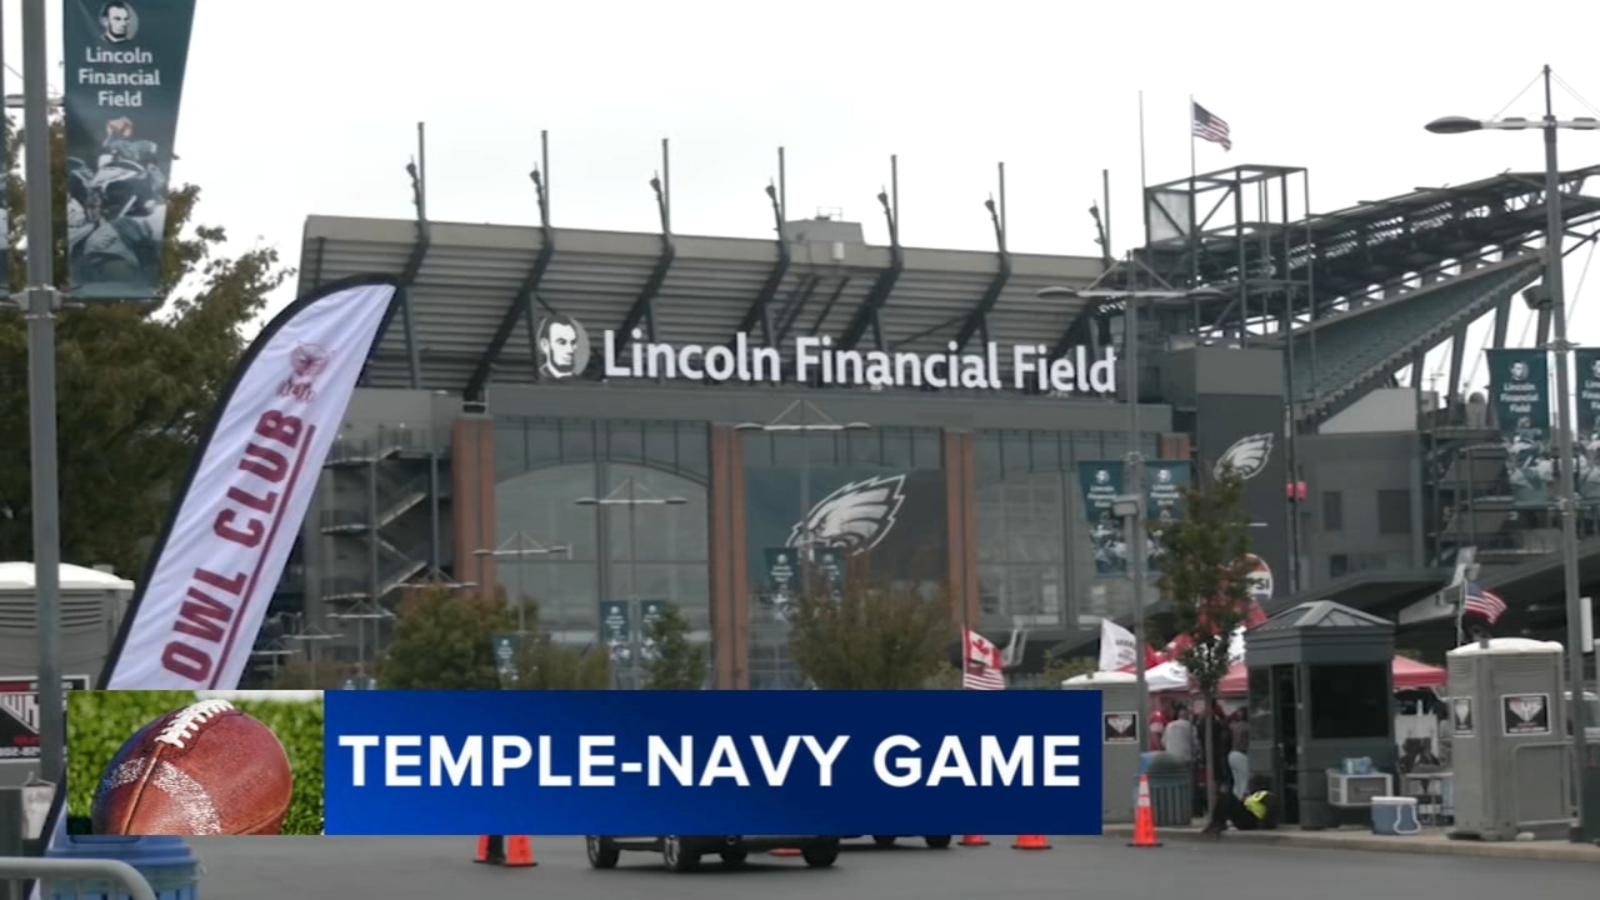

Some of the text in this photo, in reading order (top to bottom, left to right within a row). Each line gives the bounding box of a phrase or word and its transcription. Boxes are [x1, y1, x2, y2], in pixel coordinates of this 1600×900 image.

[86, 47, 153, 63] Lincoln
[78, 69, 161, 86] Financial
[98, 91, 142, 107] Field
[604, 329, 1117, 393] Lincoln Financial Field
[161, 568, 248, 682] OWL
[213, 409, 303, 549] CLUB
